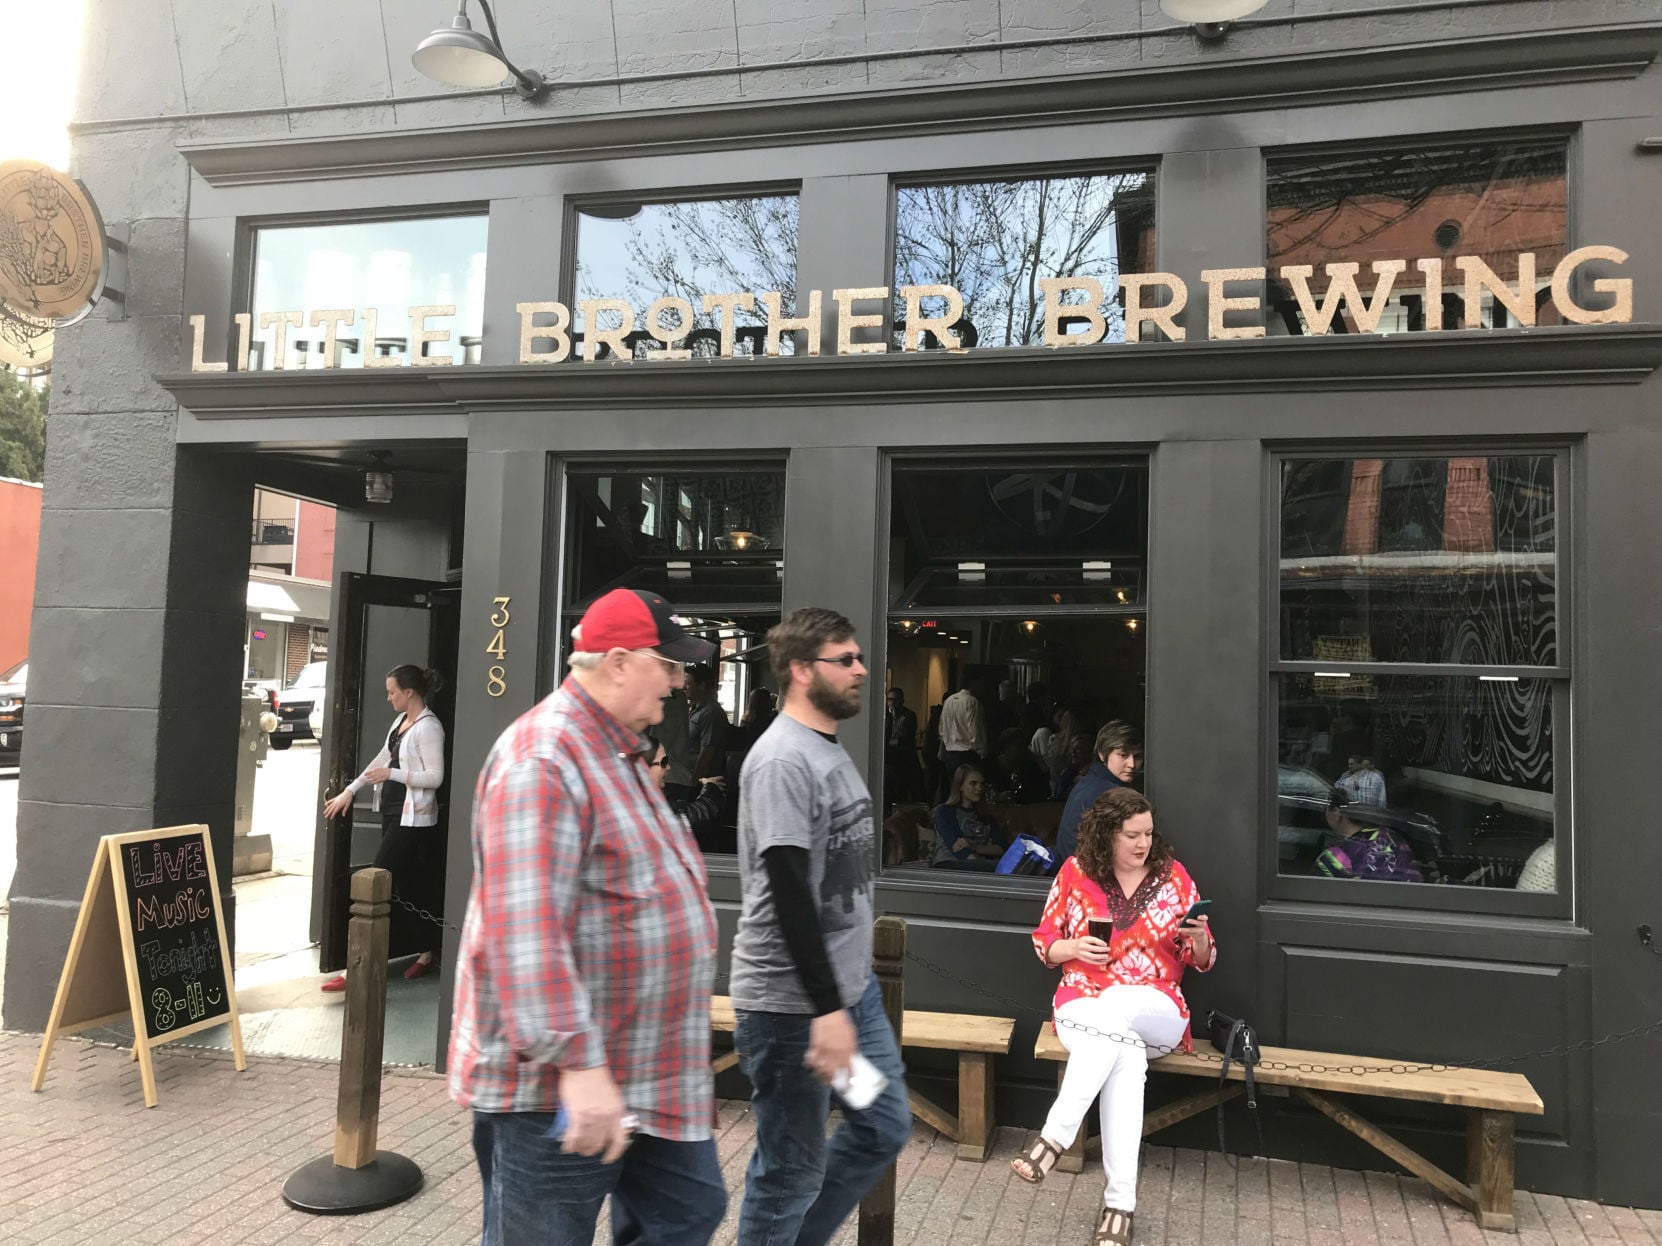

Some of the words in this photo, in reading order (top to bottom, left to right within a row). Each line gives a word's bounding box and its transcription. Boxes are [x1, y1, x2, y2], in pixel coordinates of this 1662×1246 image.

[60, 192, 89, 249] BROTHER
[188, 304, 457, 373] LITTLE
[515, 283, 964, 364] BROTHER
[1038, 244, 1634, 347] BREWING
[486, 596, 511, 697] 348
[140, 927, 217, 985] Tonight
[152, 982, 205, 1031] 8-11
